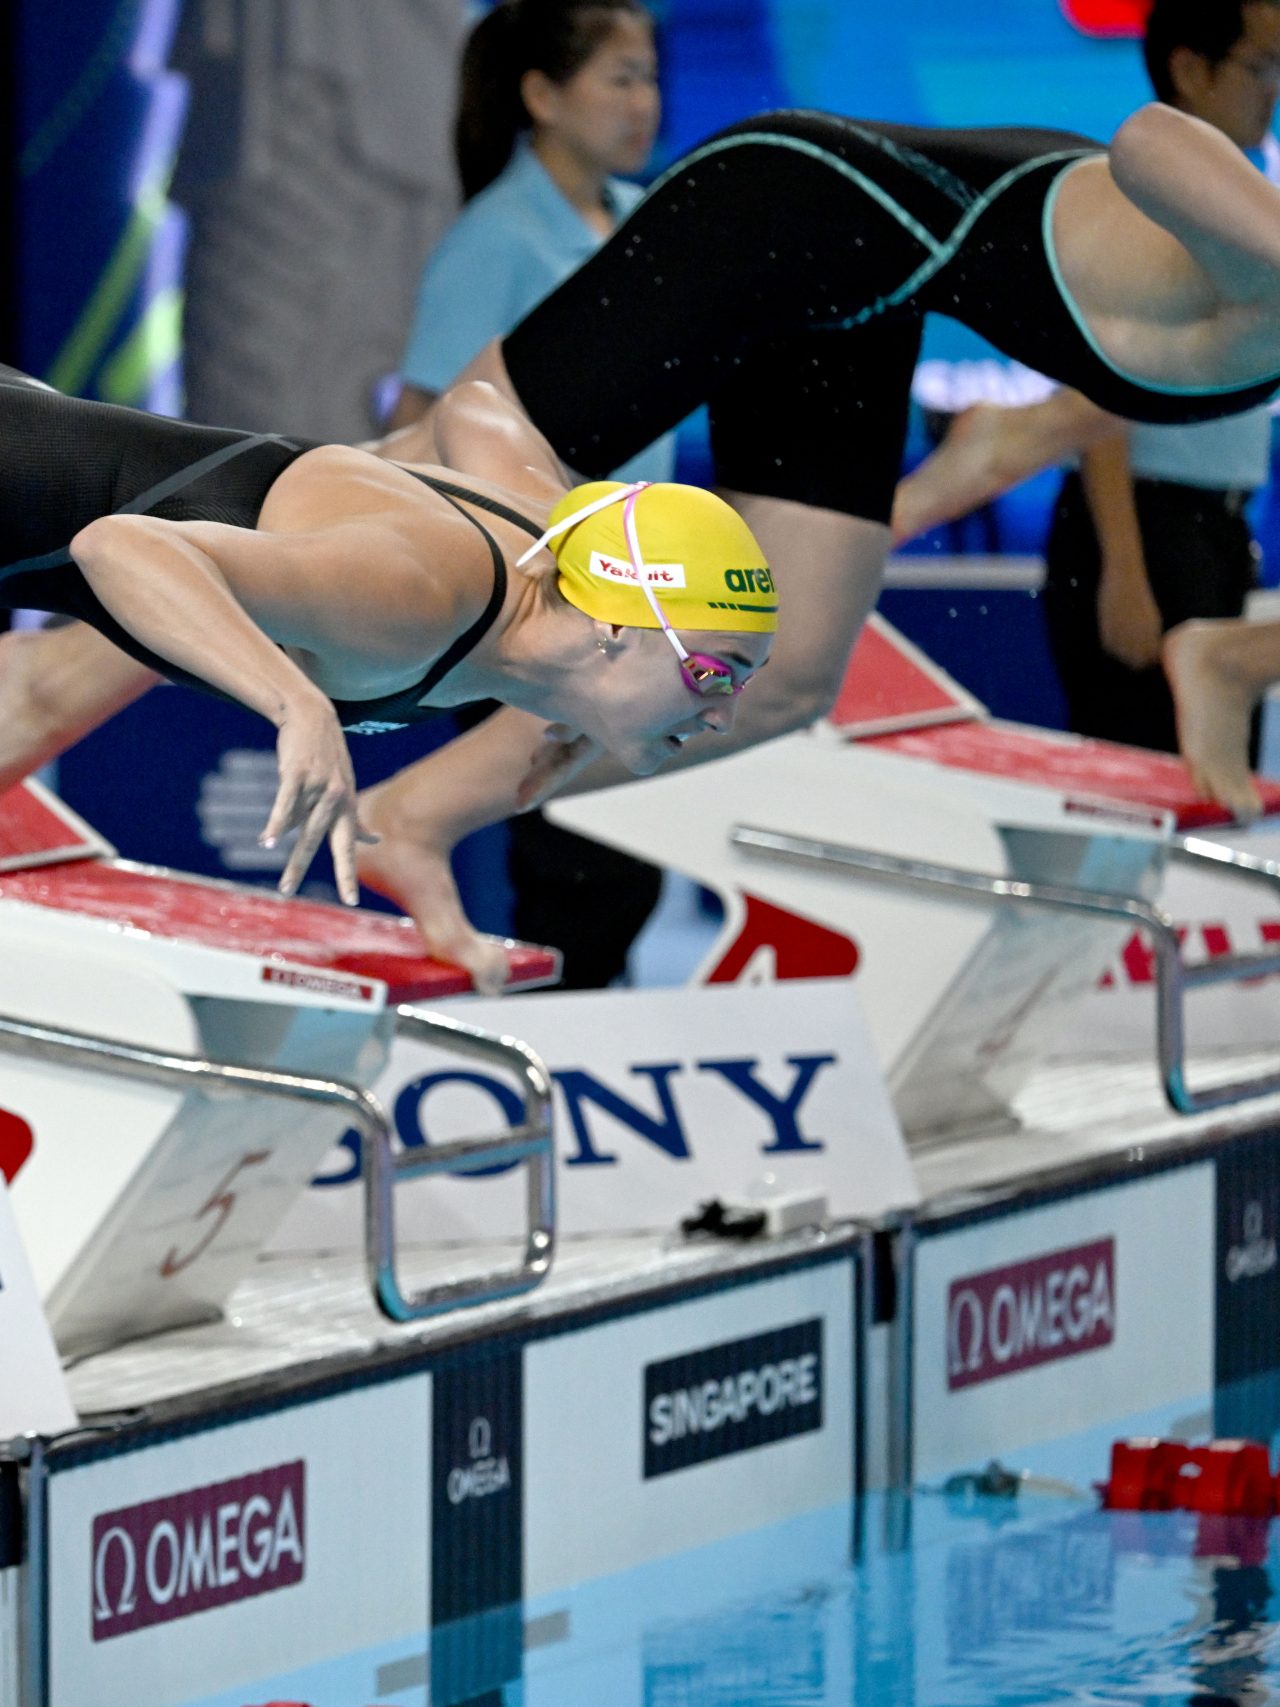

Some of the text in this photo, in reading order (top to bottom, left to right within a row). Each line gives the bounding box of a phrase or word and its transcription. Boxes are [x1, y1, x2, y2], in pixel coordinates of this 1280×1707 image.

[988, 1257, 1114, 1362] OMEGA
[649, 1352, 819, 1446] SINGAPORE
[144, 1485, 304, 1605] OMEGA
